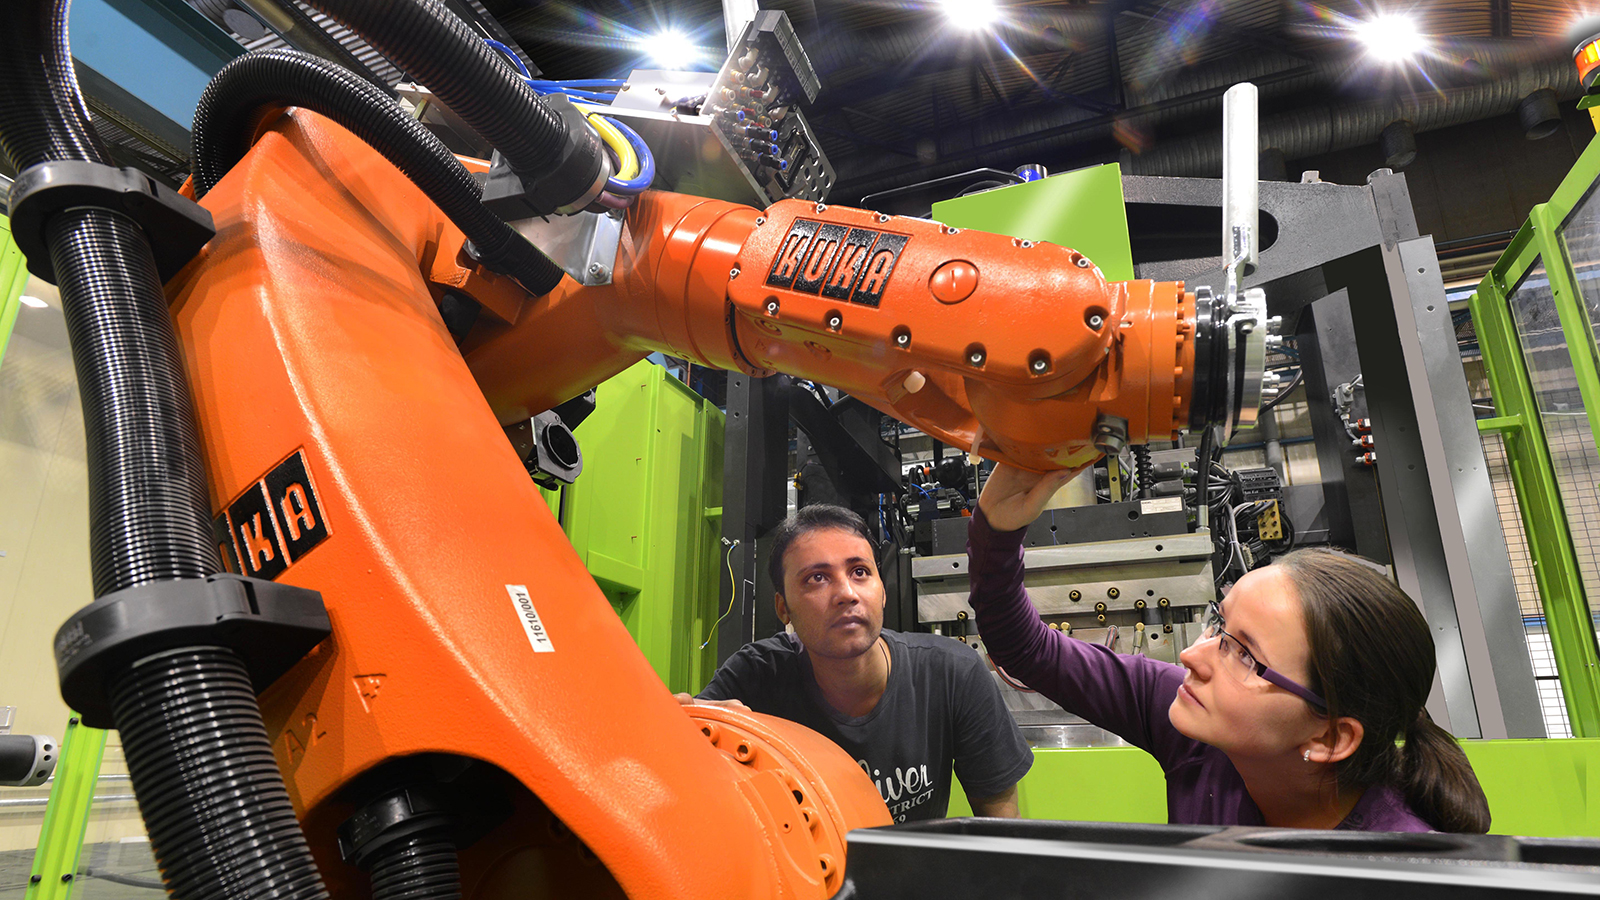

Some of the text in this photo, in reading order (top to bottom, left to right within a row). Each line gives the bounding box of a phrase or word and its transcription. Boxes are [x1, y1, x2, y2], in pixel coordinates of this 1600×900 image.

[774, 233, 895, 295] KUKA
[219, 482, 316, 573] KA
[515, 592, 547, 643] 11610/001
[888, 789, 934, 815] TRICT
